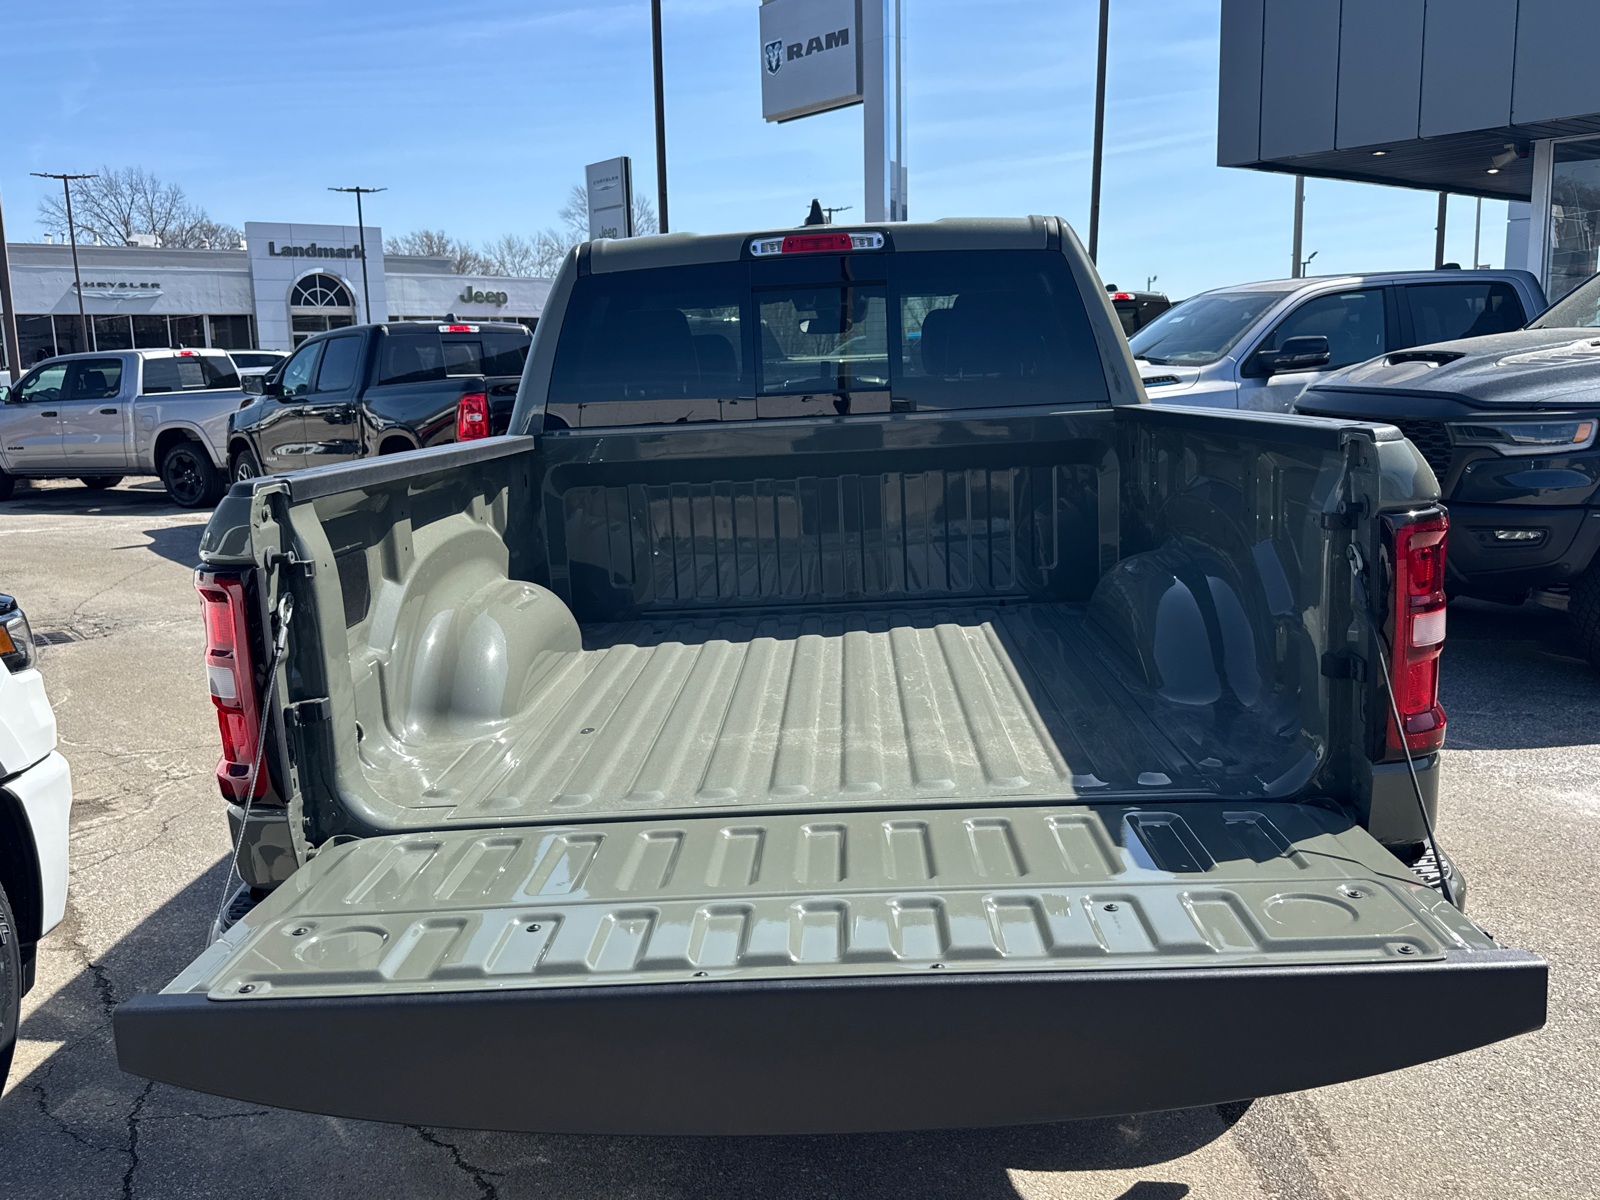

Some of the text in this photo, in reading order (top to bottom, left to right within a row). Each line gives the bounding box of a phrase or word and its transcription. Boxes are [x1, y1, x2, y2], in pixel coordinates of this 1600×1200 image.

[786, 28, 849, 61] RAM
[598, 225, 618, 239] Jeep
[268, 241, 367, 259] Landmark
[72, 281, 161, 289] CHRYSLER
[459, 285, 508, 308] Jeep
